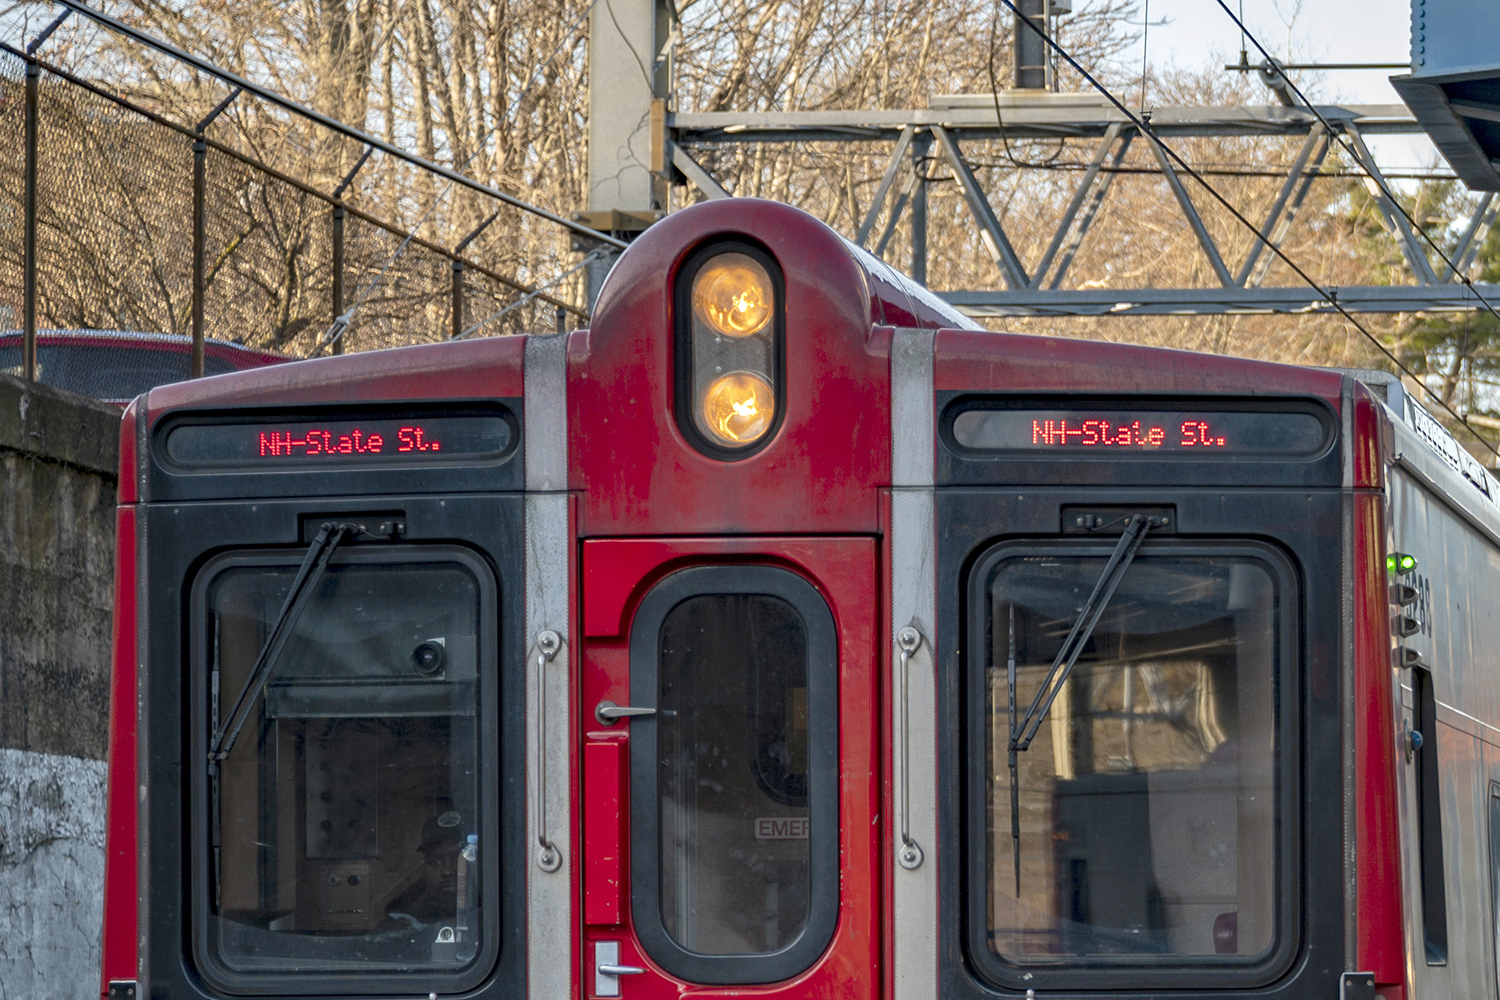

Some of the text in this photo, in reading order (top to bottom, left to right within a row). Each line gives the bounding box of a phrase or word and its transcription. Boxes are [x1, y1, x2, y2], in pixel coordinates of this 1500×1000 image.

[259, 426, 441, 456] NH-State St.
[1180, 420, 1226, 446] St.
